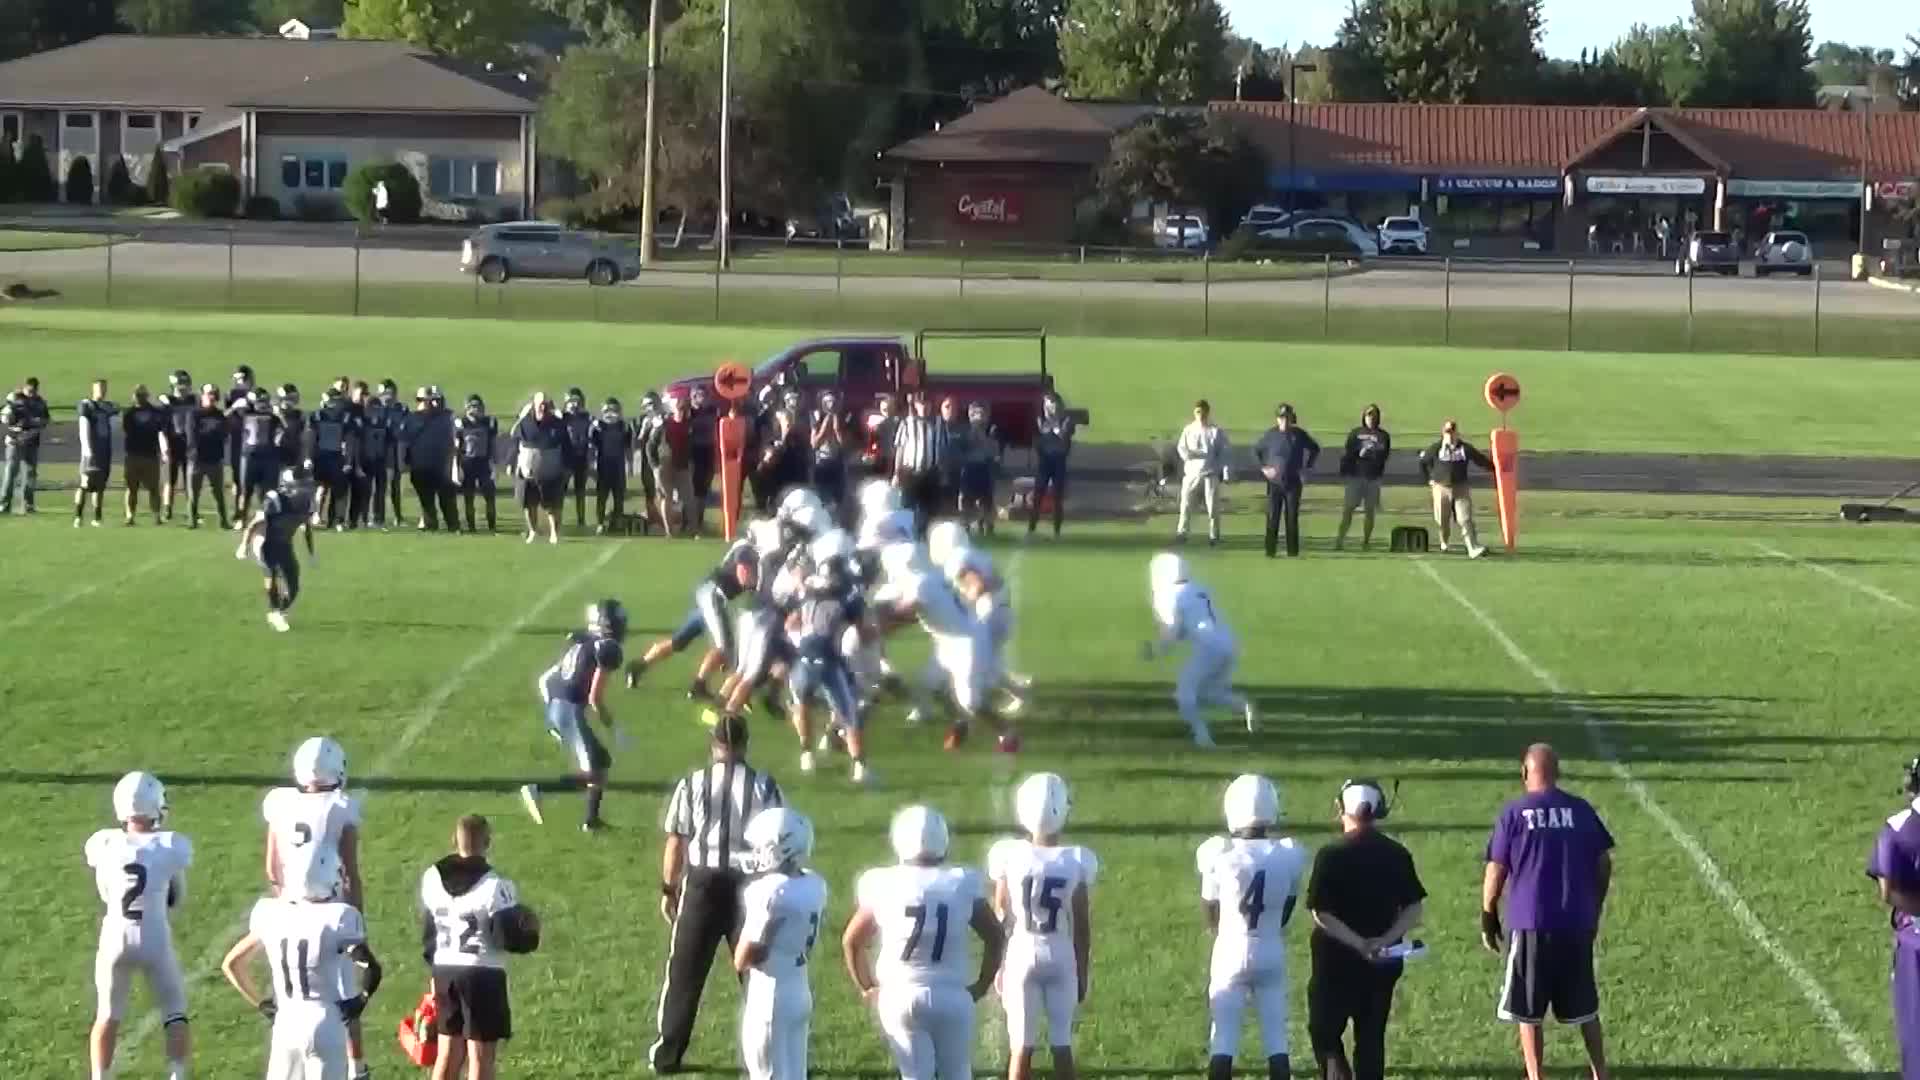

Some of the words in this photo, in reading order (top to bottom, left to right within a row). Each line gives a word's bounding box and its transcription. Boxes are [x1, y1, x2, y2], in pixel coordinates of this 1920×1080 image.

[1521, 806, 1574, 831] TEAM
[121, 863, 148, 920] 2
[1021, 876, 1067, 934] 15
[1239, 869, 1267, 931] 4
[903, 902, 950, 962] 71
[280, 937, 315, 1000] 11
